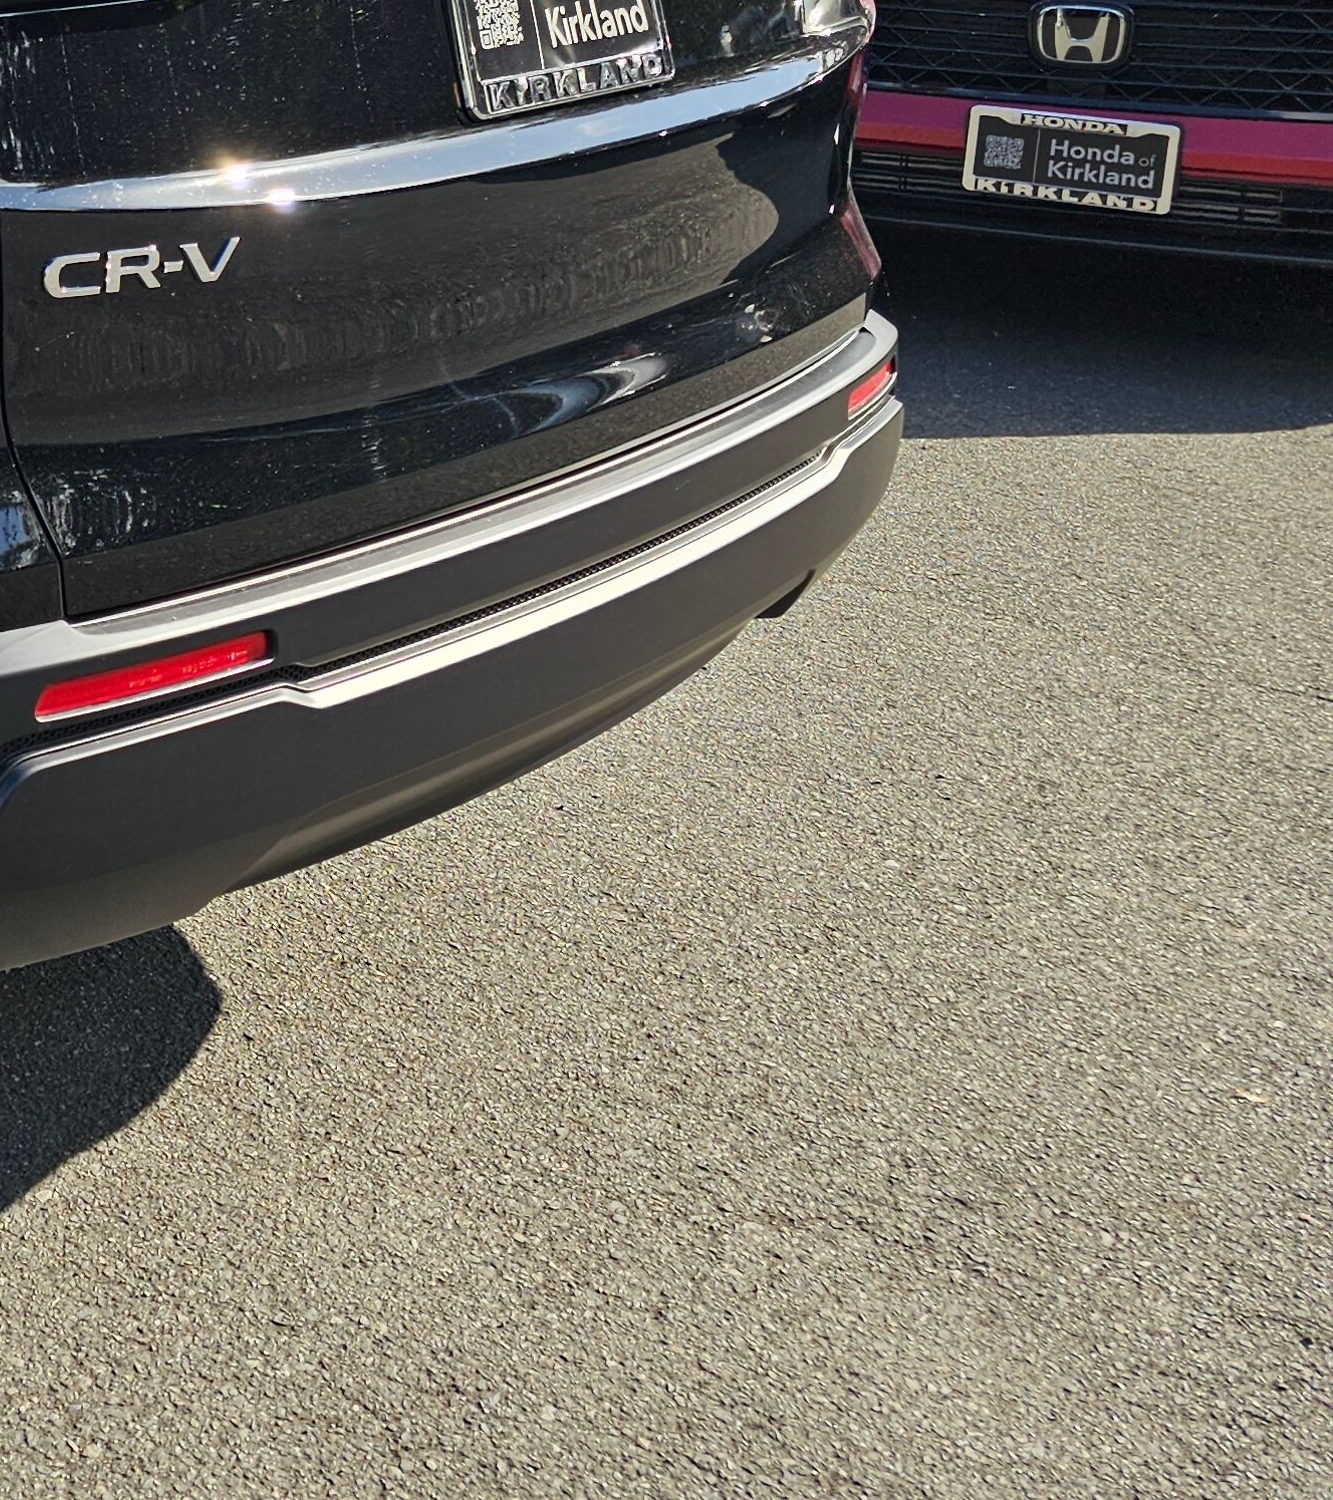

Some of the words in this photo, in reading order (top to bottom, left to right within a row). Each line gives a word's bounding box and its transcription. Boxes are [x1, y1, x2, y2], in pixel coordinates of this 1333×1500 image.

[489, 54, 663, 112] KIRKLAND
[1023, 114, 1124, 135] HONDA
[1049, 138, 1135, 165] Honda
[1138, 154, 1157, 168] of
[1047, 159, 1155, 189] Kirkland
[976, 178, 1157, 211] KIRKLAND
[43, 236, 241, 299] CR-V
